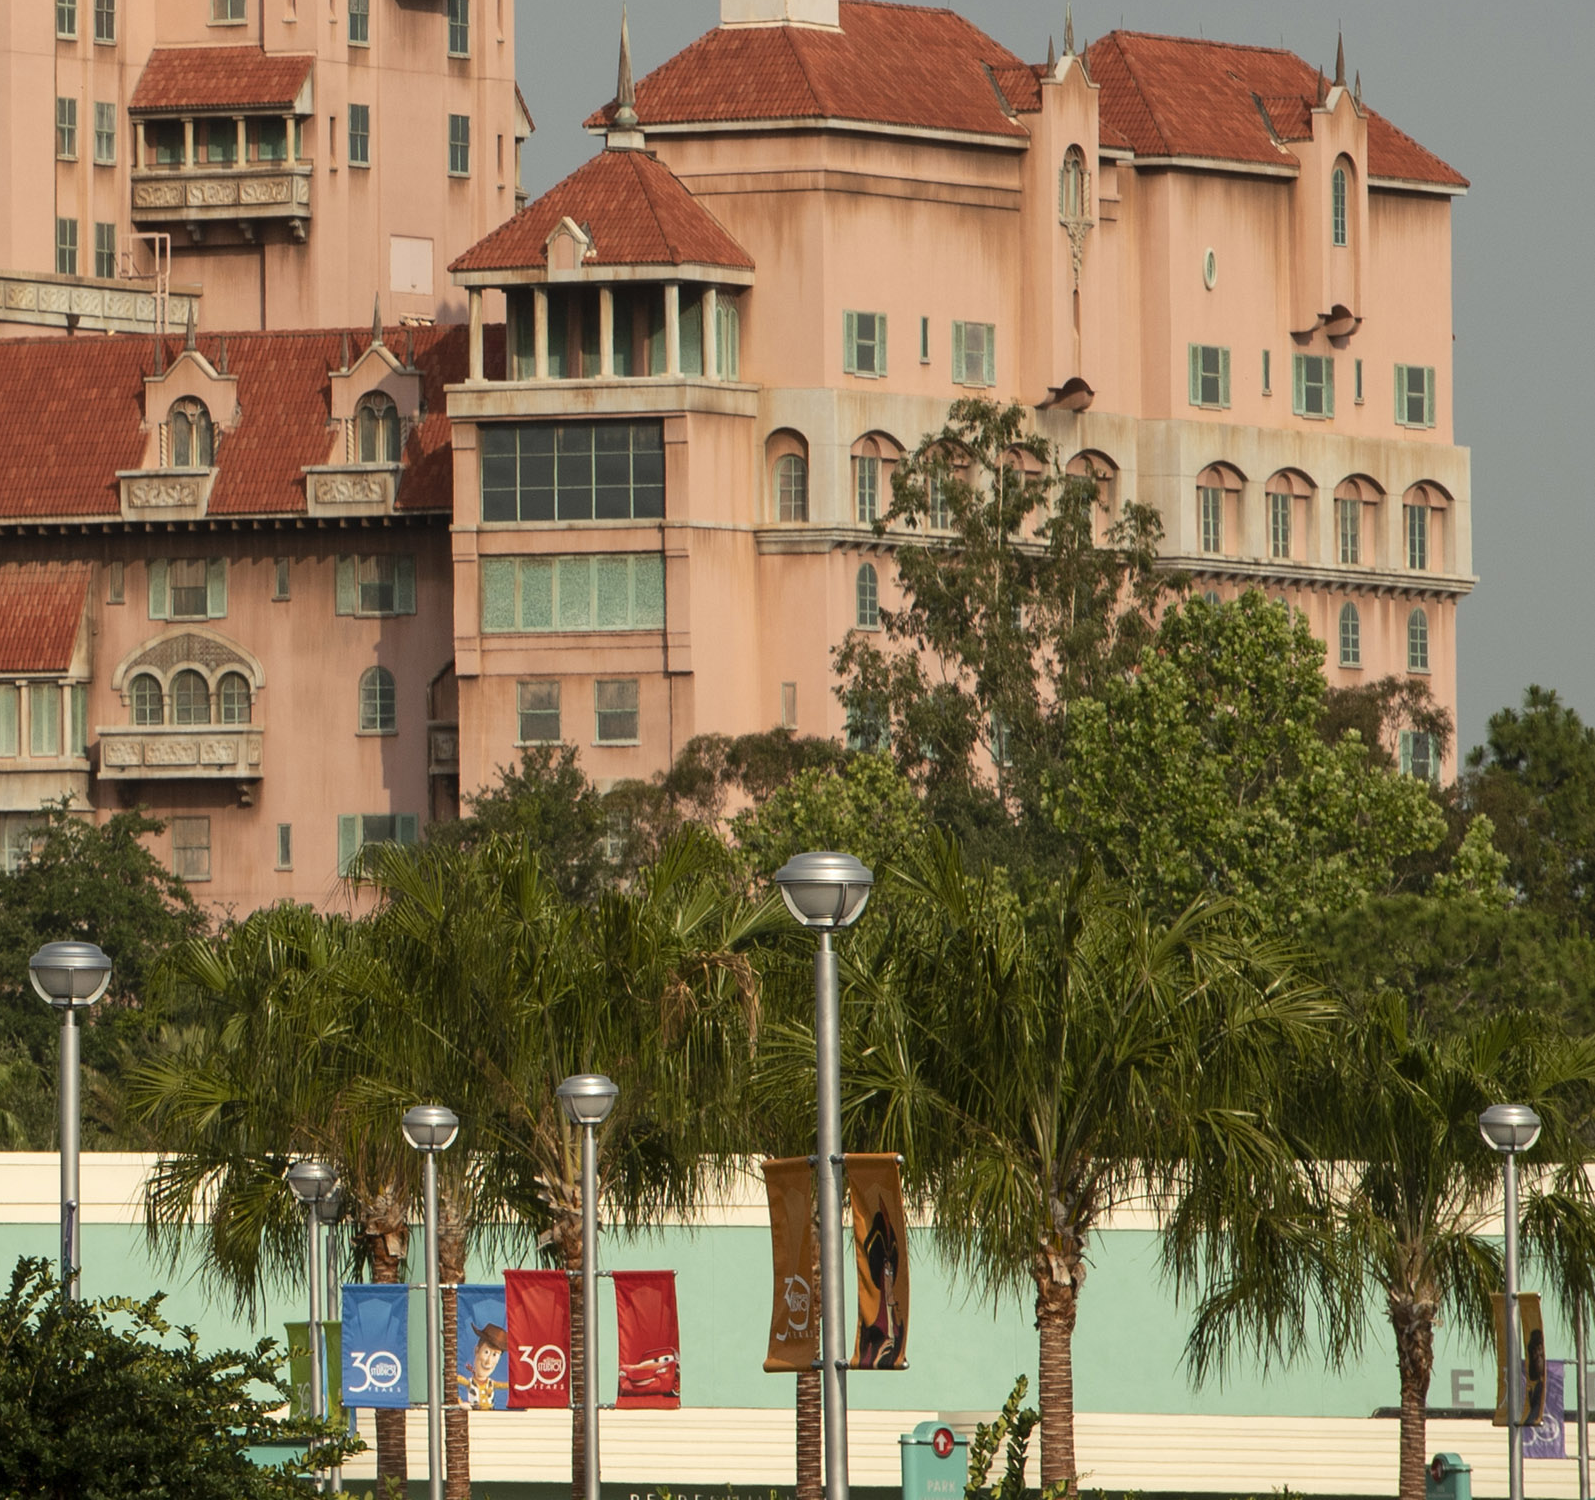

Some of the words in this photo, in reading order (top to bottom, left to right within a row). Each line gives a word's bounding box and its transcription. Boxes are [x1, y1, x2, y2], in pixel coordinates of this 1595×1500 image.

[349, 1351, 402, 1392] 30
[514, 1345, 566, 1390] 30
[926, 1479, 956, 1493] PARK
